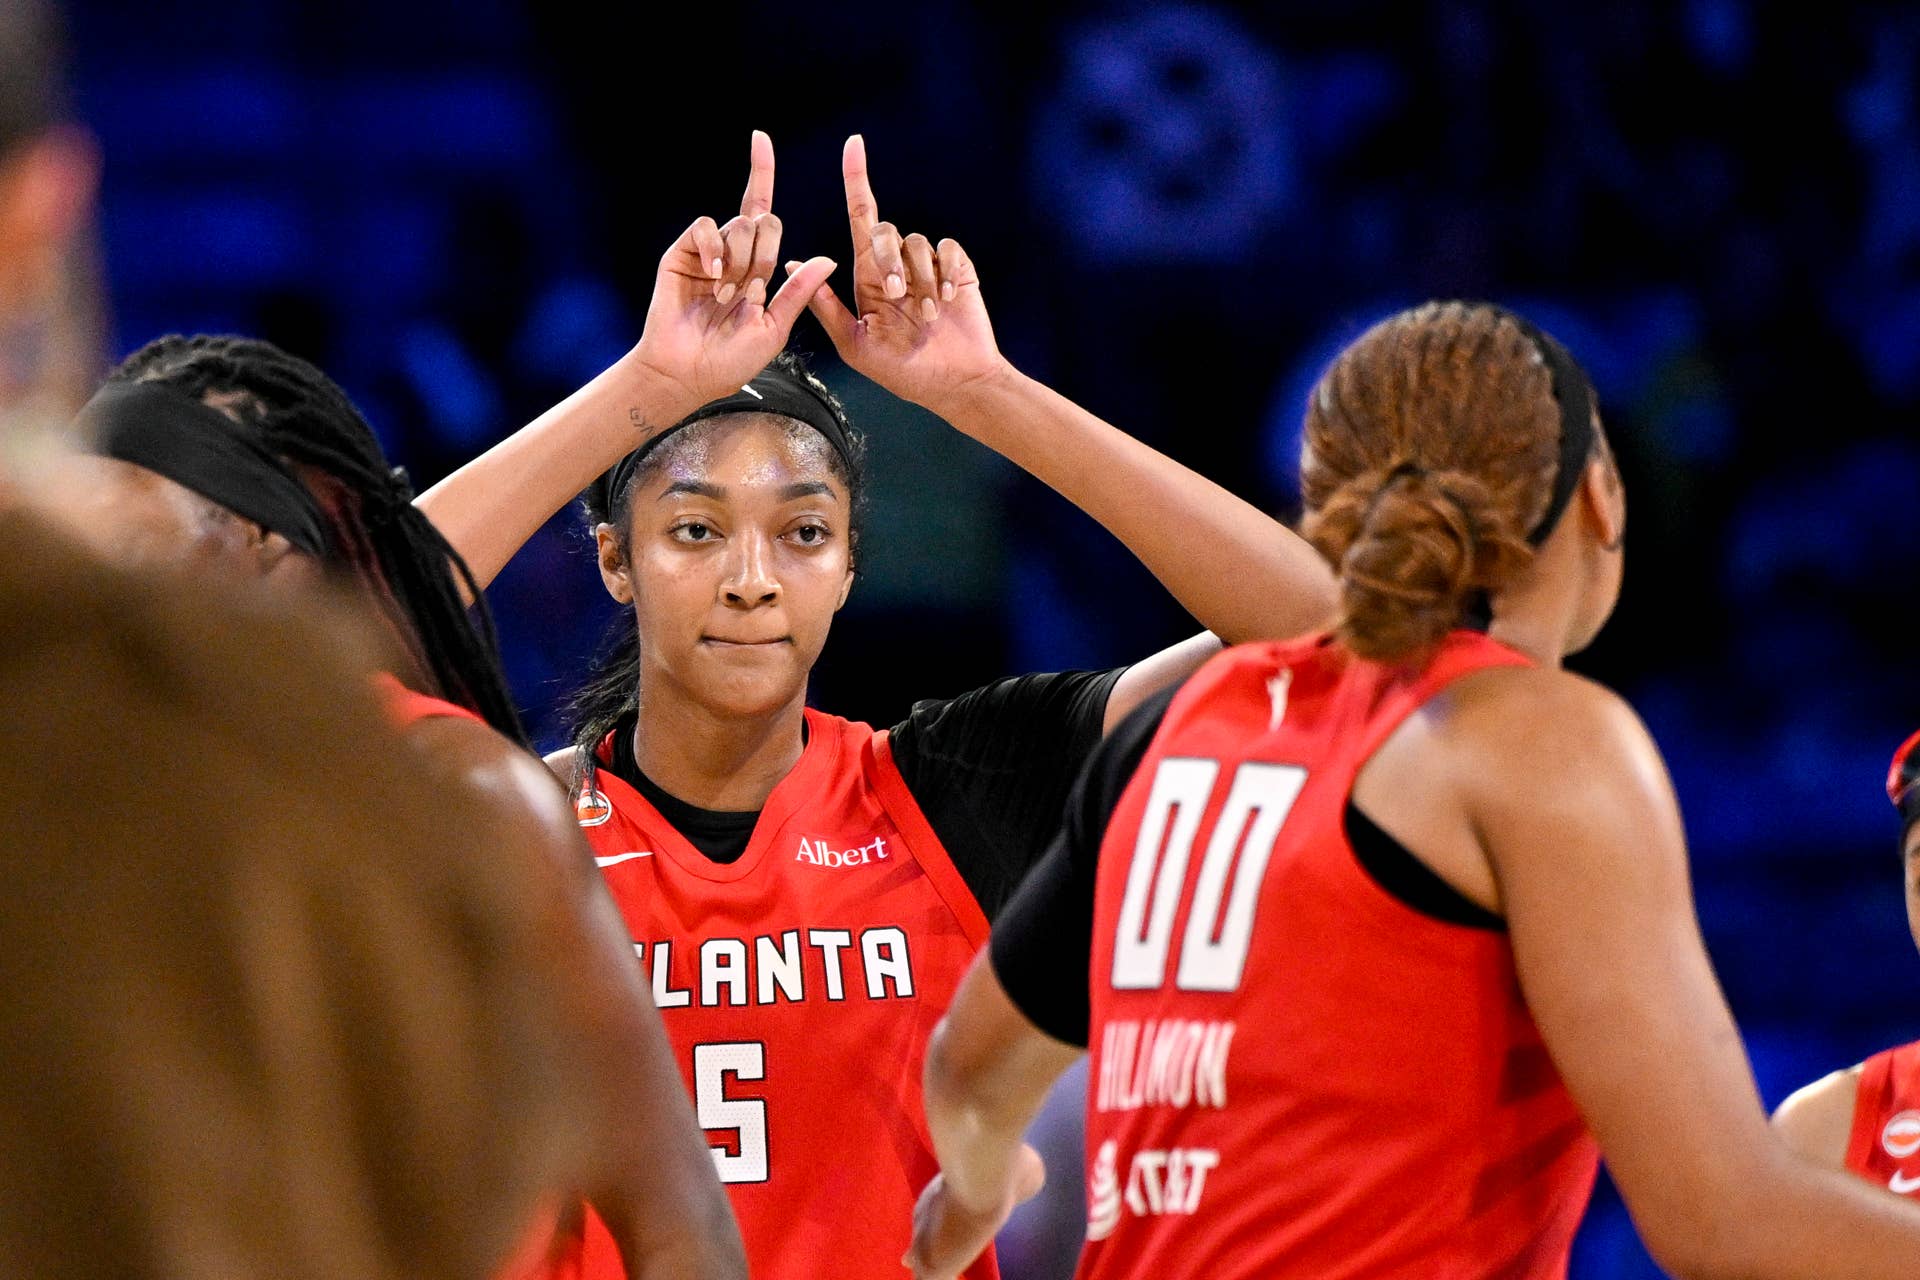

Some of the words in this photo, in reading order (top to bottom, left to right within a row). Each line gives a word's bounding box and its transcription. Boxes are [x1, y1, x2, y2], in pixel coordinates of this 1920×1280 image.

[795, 836, 888, 868] Albert
[1111, 757, 1309, 993] 00
[633, 926, 914, 1008] LANTA
[693, 1041, 769, 1184] 5
